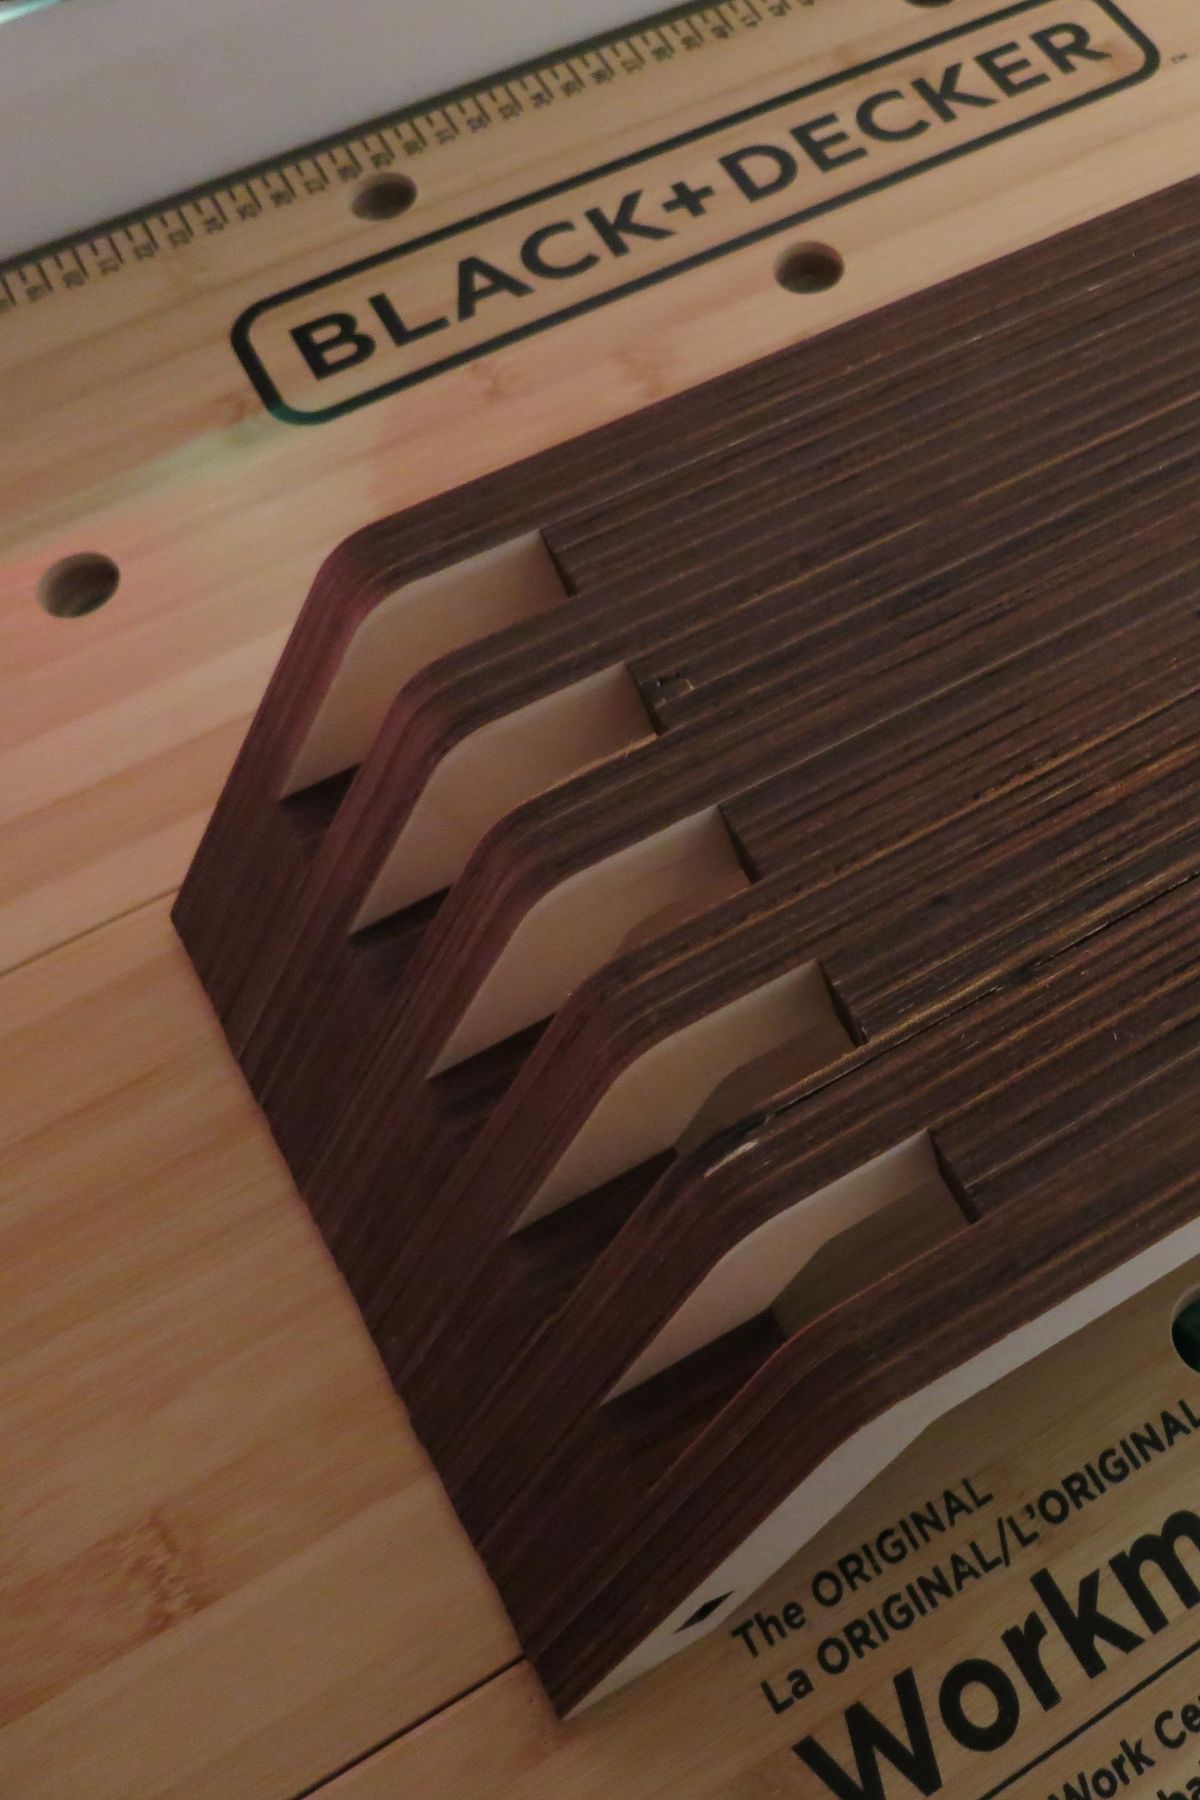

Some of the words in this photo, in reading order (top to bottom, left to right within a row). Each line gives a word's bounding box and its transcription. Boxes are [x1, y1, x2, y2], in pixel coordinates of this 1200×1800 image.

[289, 19, 1113, 381] BLACK+DECKER
[731, 1599, 807, 1660] The
[810, 1477, 996, 1608] ORIGINAL
[760, 1668, 815, 1715] La
